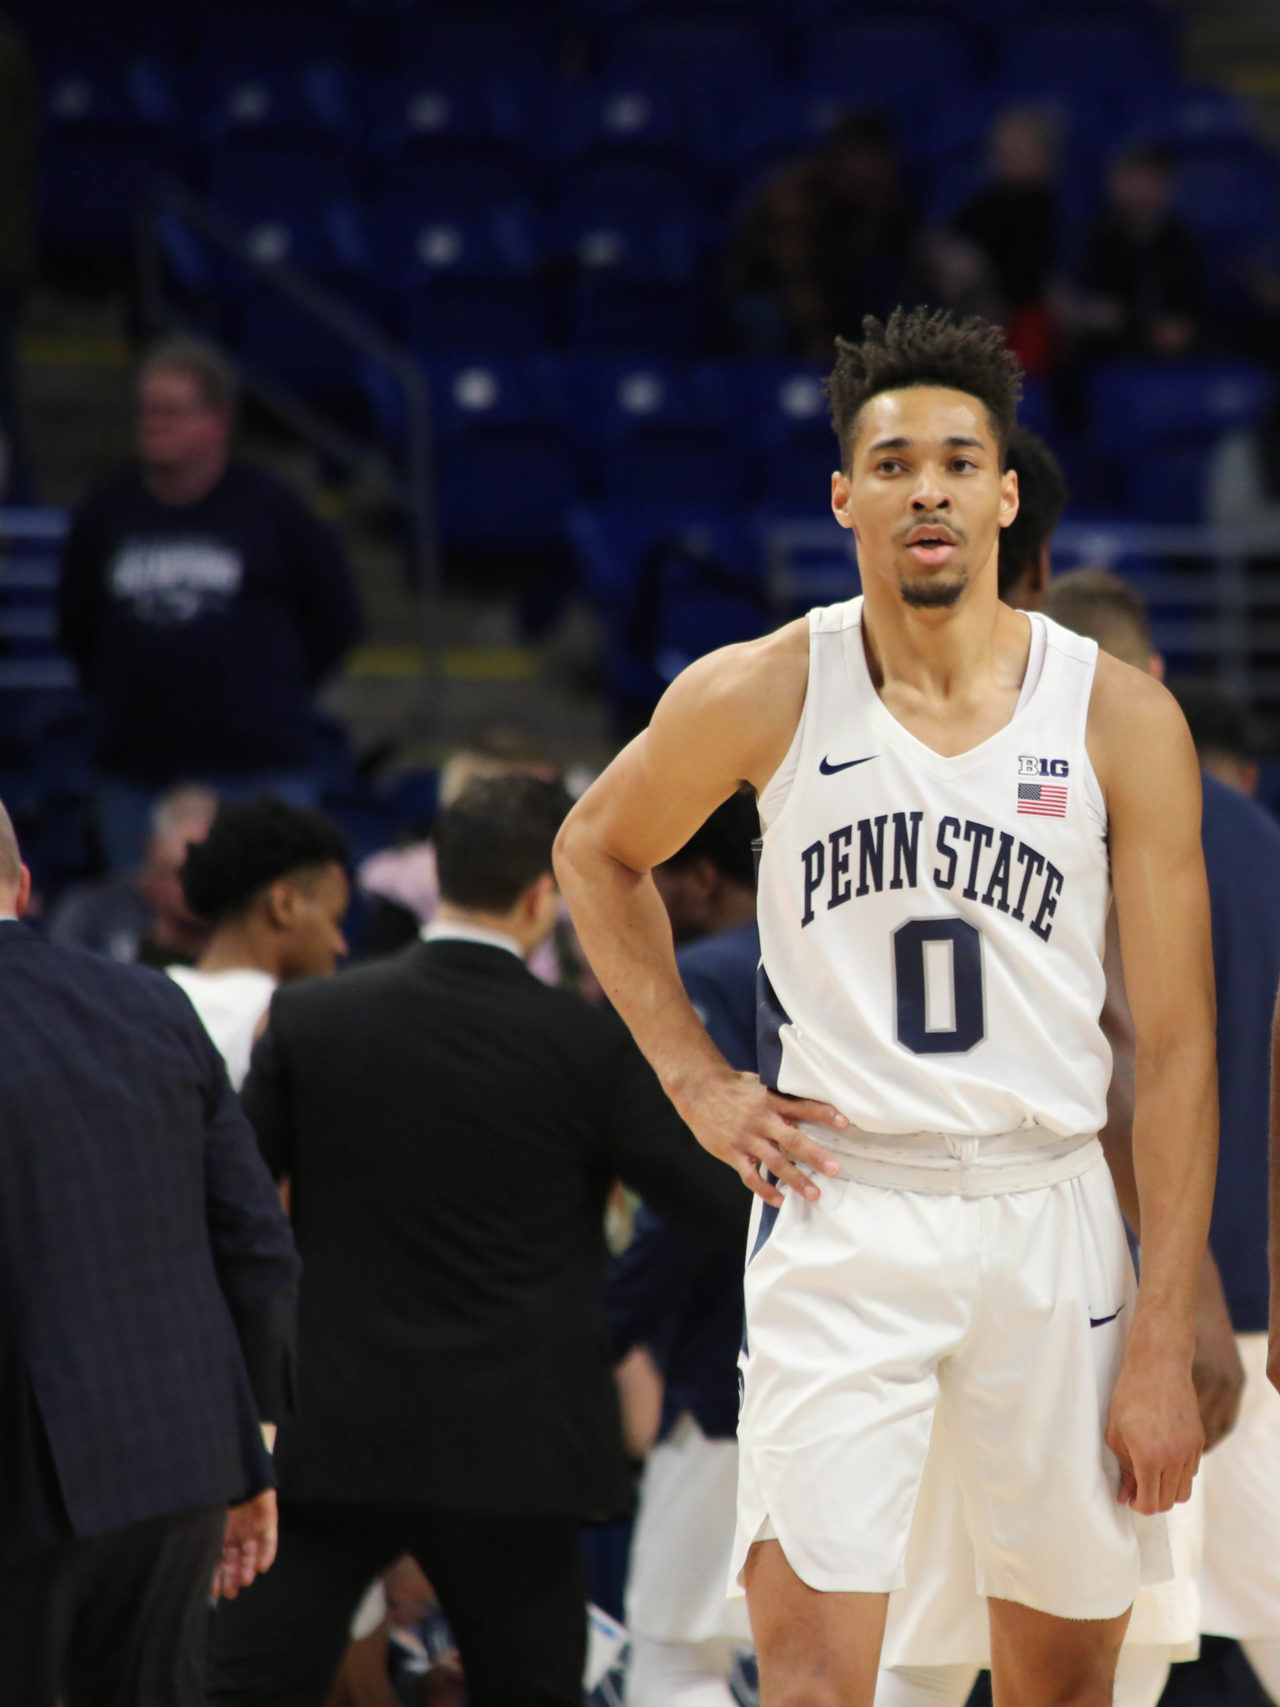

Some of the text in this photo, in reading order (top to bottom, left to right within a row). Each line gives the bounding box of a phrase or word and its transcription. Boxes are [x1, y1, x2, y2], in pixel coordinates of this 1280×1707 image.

[801, 811, 1064, 943] PENN STATE
[890, 914, 988, 1055] 0
